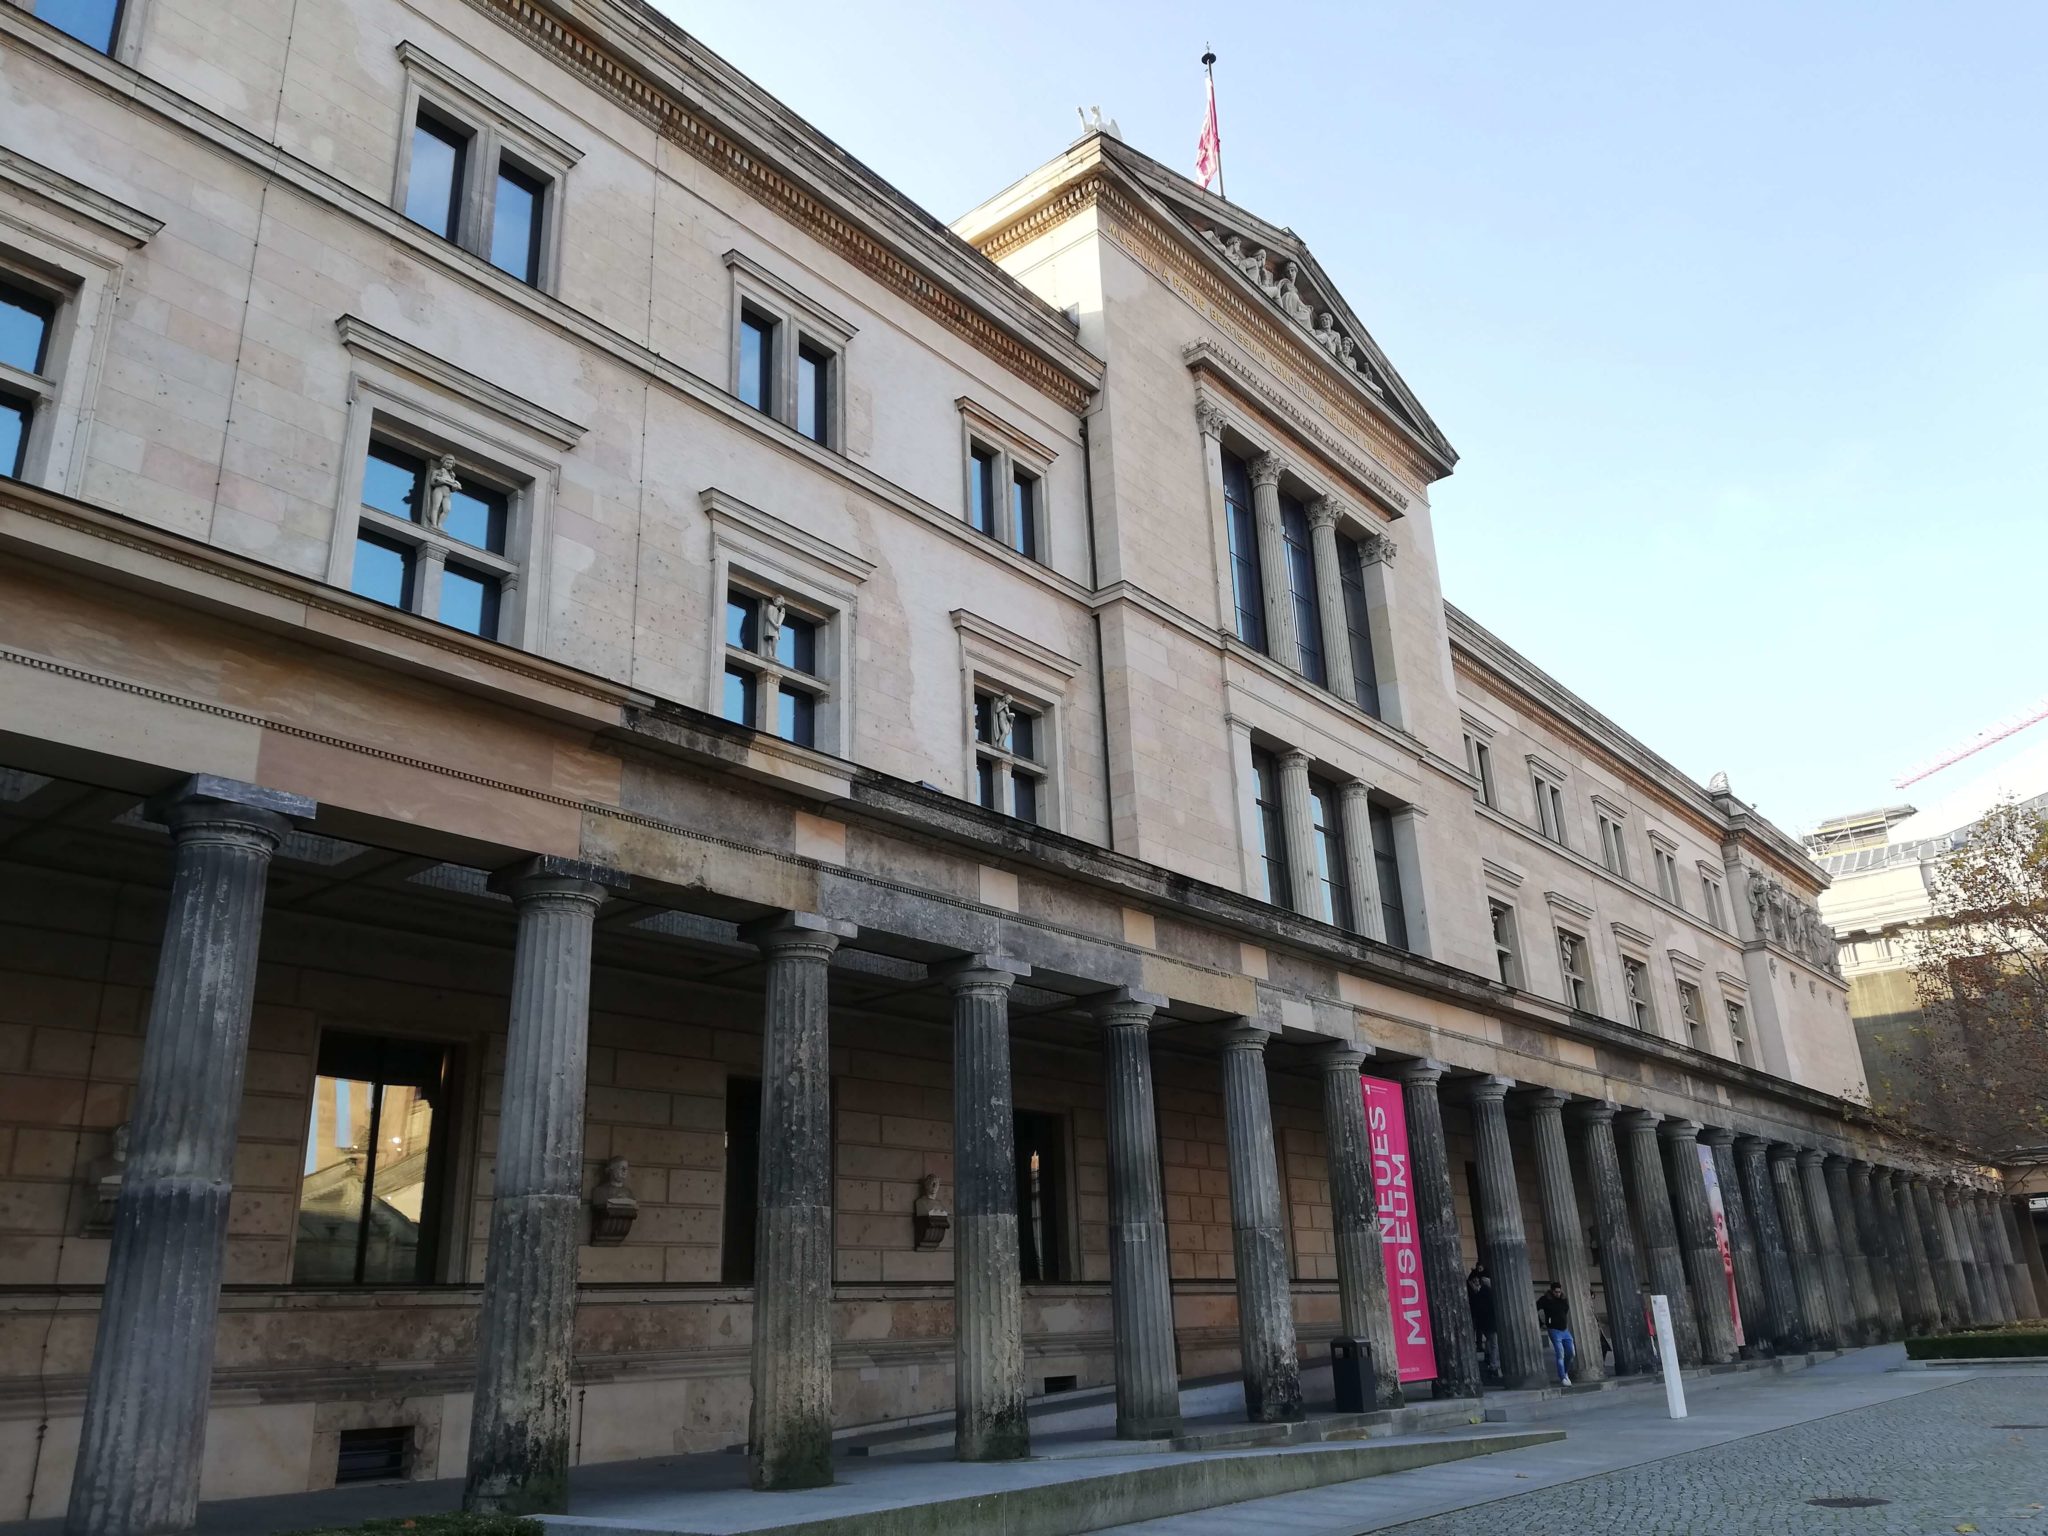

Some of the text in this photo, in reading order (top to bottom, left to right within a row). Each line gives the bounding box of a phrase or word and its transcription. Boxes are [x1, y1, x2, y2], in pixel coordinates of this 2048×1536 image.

[1108, 222, 1158, 272] MUSEUM
[1162, 268, 1170, 282] A
[1173, 276, 1205, 312] PATRE
[1210, 307, 1266, 362] BEATISSIMO
[1270, 359, 1315, 405] CONDITUM
[1369, 1106, 1396, 1243] NEUES
[1391, 1154, 1427, 1345] MUSEUM
